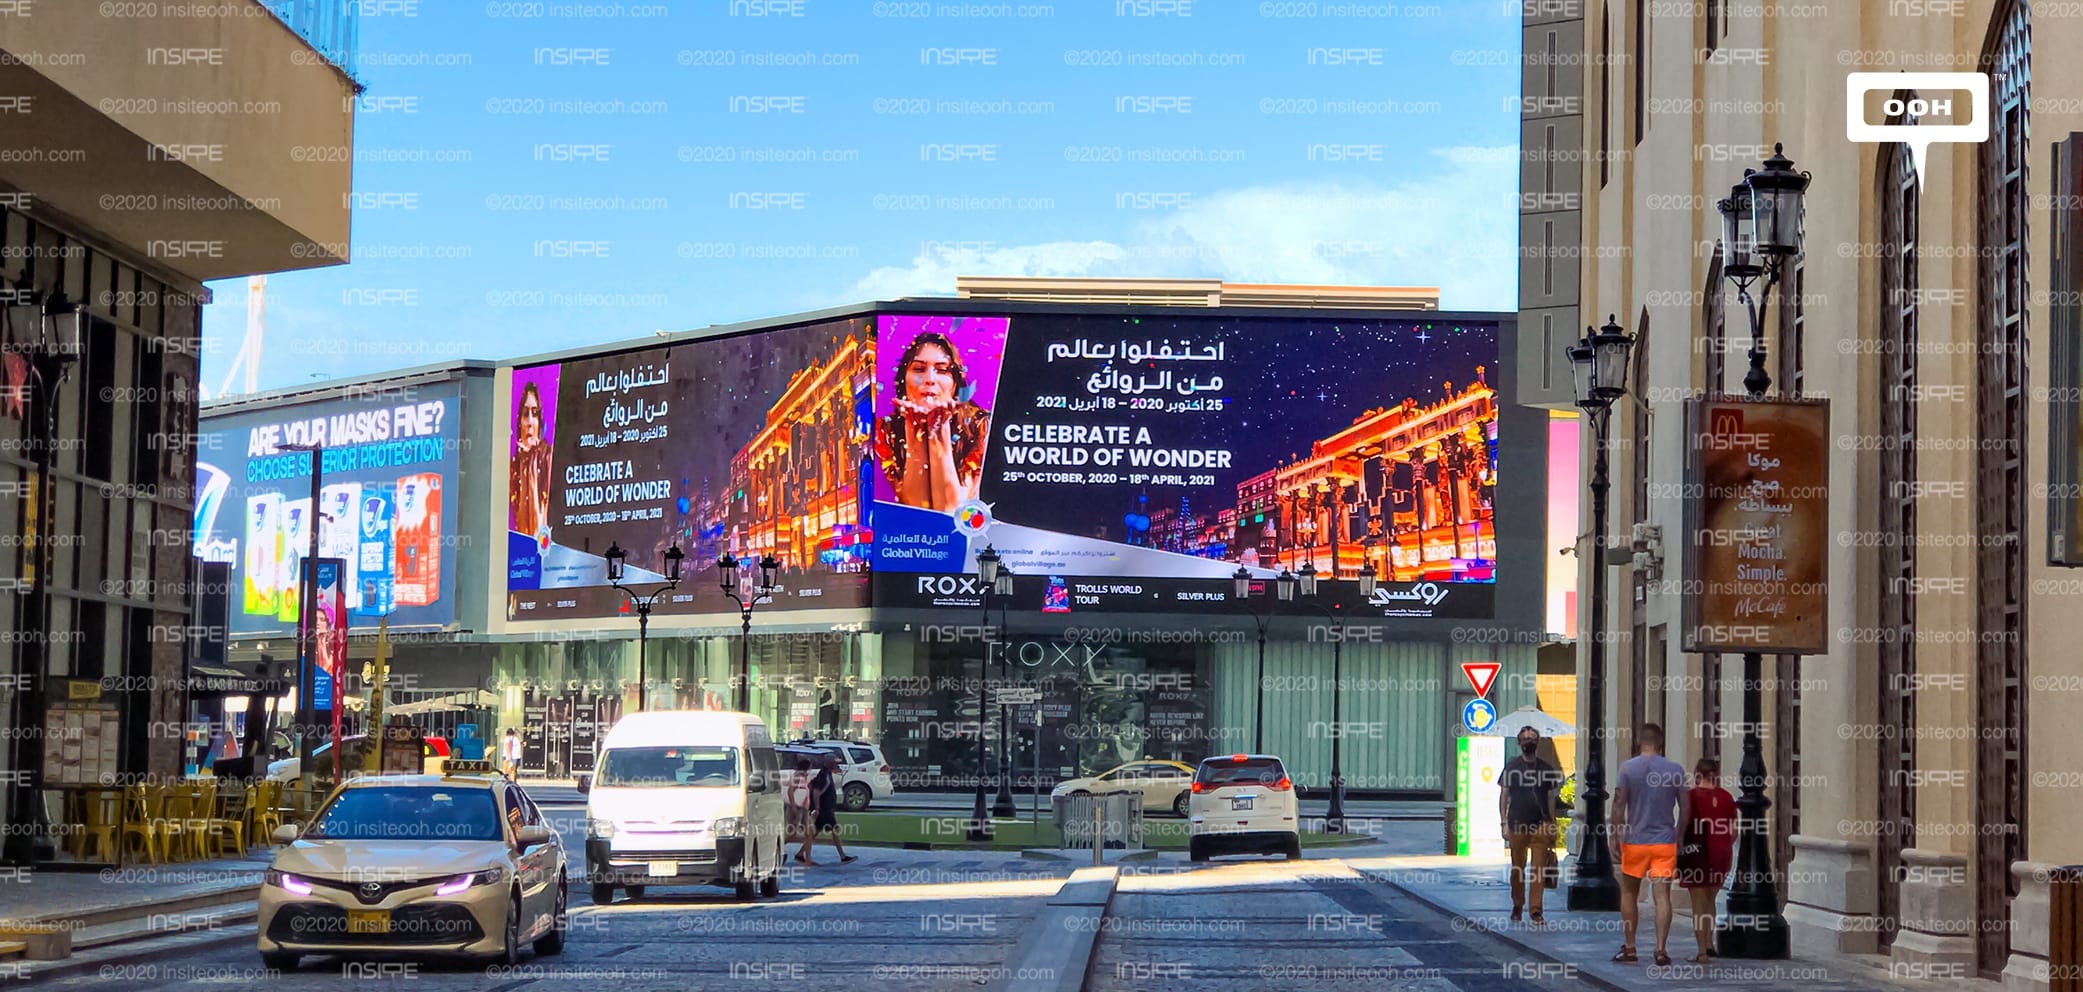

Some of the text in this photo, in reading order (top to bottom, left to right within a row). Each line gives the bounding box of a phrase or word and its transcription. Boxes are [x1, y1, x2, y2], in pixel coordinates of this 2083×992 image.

[1047, 338, 1225, 365] احتفلوا بعالم
[1086, 366, 1224, 395] من الروائع
[1036, 396, 1066, 408] 2021
[1102, 397, 1116, 409] 18
[1130, 397, 1164, 410] 2020
[1206, 399, 1224, 411] 25
[248, 401, 445, 457] ARE YOUR MASKS FINE?
[1003, 424, 1152, 444] CELEBRATE A
[247, 437, 444, 482] CHOOSE SUERIOR PROTECTION
[1003, 446, 1232, 468] WORLD OF WONDER
[565, 460, 633, 484] CELEBRATE A
[1027, 472, 1086, 485] OCTOBER,
[1088, 473, 1117, 484] 2020
[1151, 474, 1188, 487] APRIL,
[1190, 475, 1215, 485] 2021
[565, 480, 671, 507] WORLD OF WONDER
[1744, 523, 1782, 538] Great
[881, 547, 949, 560] Global Village
[1738, 544, 1787, 559] Mocha.
[1737, 564, 1788, 582] Simple.
[1075, 584, 1142, 595] TROLLS WORLD
[1177, 592, 1225, 601] SILVER PLUS
[1075, 596, 1100, 605] TOUR
[989, 641, 1107, 666] ROXY
[450, 761, 484, 770] TAXI
